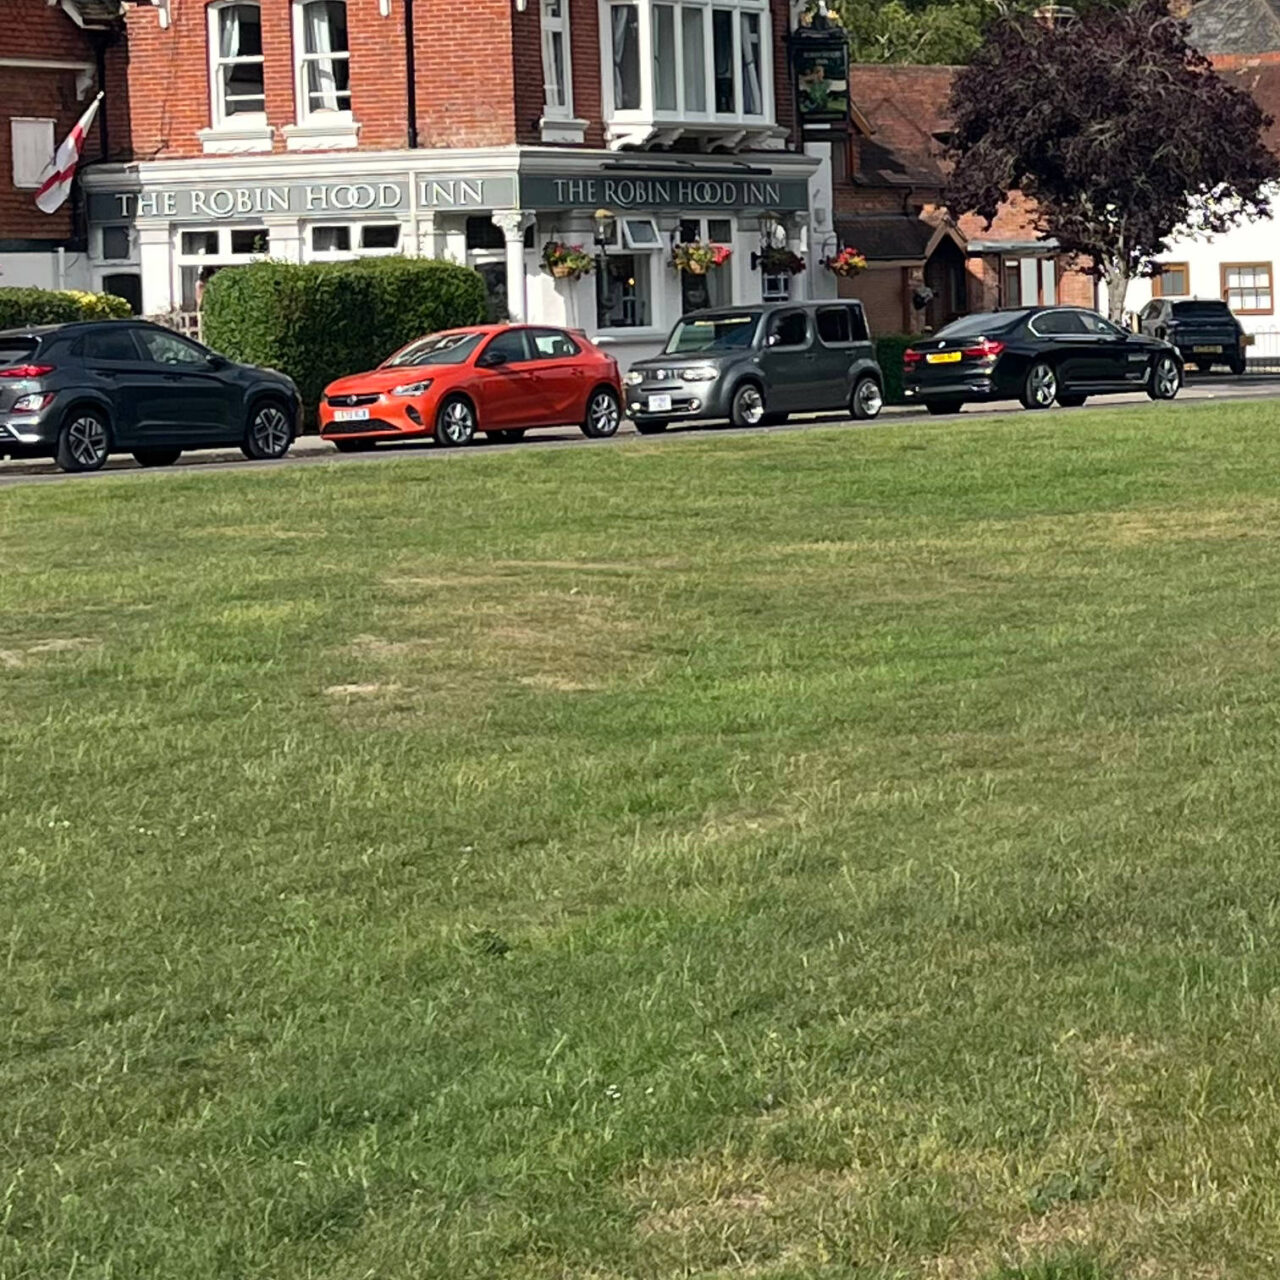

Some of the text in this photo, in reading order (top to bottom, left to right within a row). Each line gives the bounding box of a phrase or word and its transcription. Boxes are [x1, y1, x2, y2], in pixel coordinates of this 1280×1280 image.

[115, 180, 484, 218] THE ROBIN HOOD INN
[553, 179, 780, 208] THE ROBIN HOOD INN
